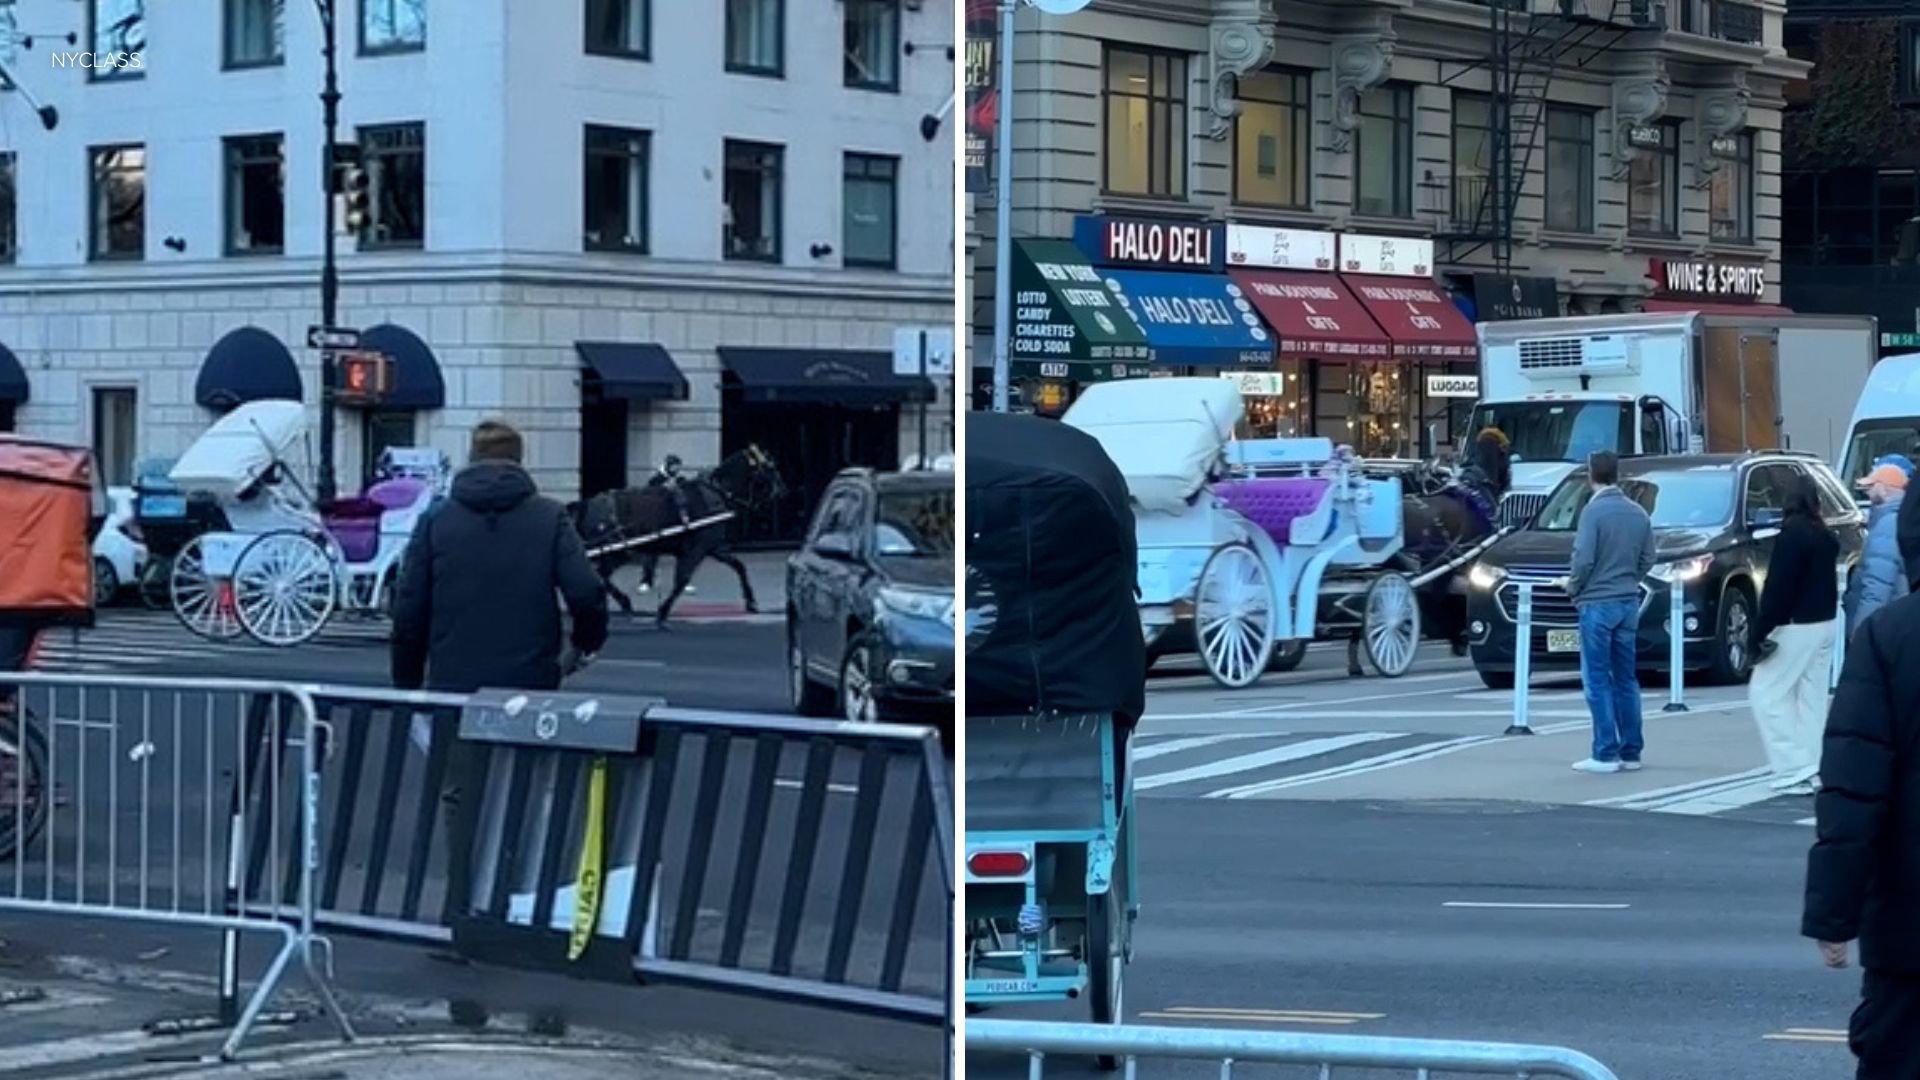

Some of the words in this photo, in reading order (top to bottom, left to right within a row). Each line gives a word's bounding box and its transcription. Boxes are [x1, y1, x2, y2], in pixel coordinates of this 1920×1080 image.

[1110, 222, 1162, 261] HALO
[1168, 226, 1212, 265] DELI
[1035, 262, 1069, 280] NEW
[1063, 264, 1102, 282] YORK
[1667, 262, 1703, 292] WINE
[1706, 264, 1716, 293] &
[1720, 266, 1763, 295] SPIRITS
[1017, 291, 1047, 305] LOTTO
[1061, 288, 1111, 307] LOTTERY
[1017, 307, 1052, 321] CANDY
[1138, 296, 1191, 324] HALO
[1187, 298, 1234, 325] DELI
[1016, 323, 1076, 338] CIGARETTES
[1306, 315, 1340, 331] GIFTS
[1410, 315, 1441, 330] GIFTS
[1015, 338, 1042, 353] COLD
[1043, 341, 1071, 354] SODA
